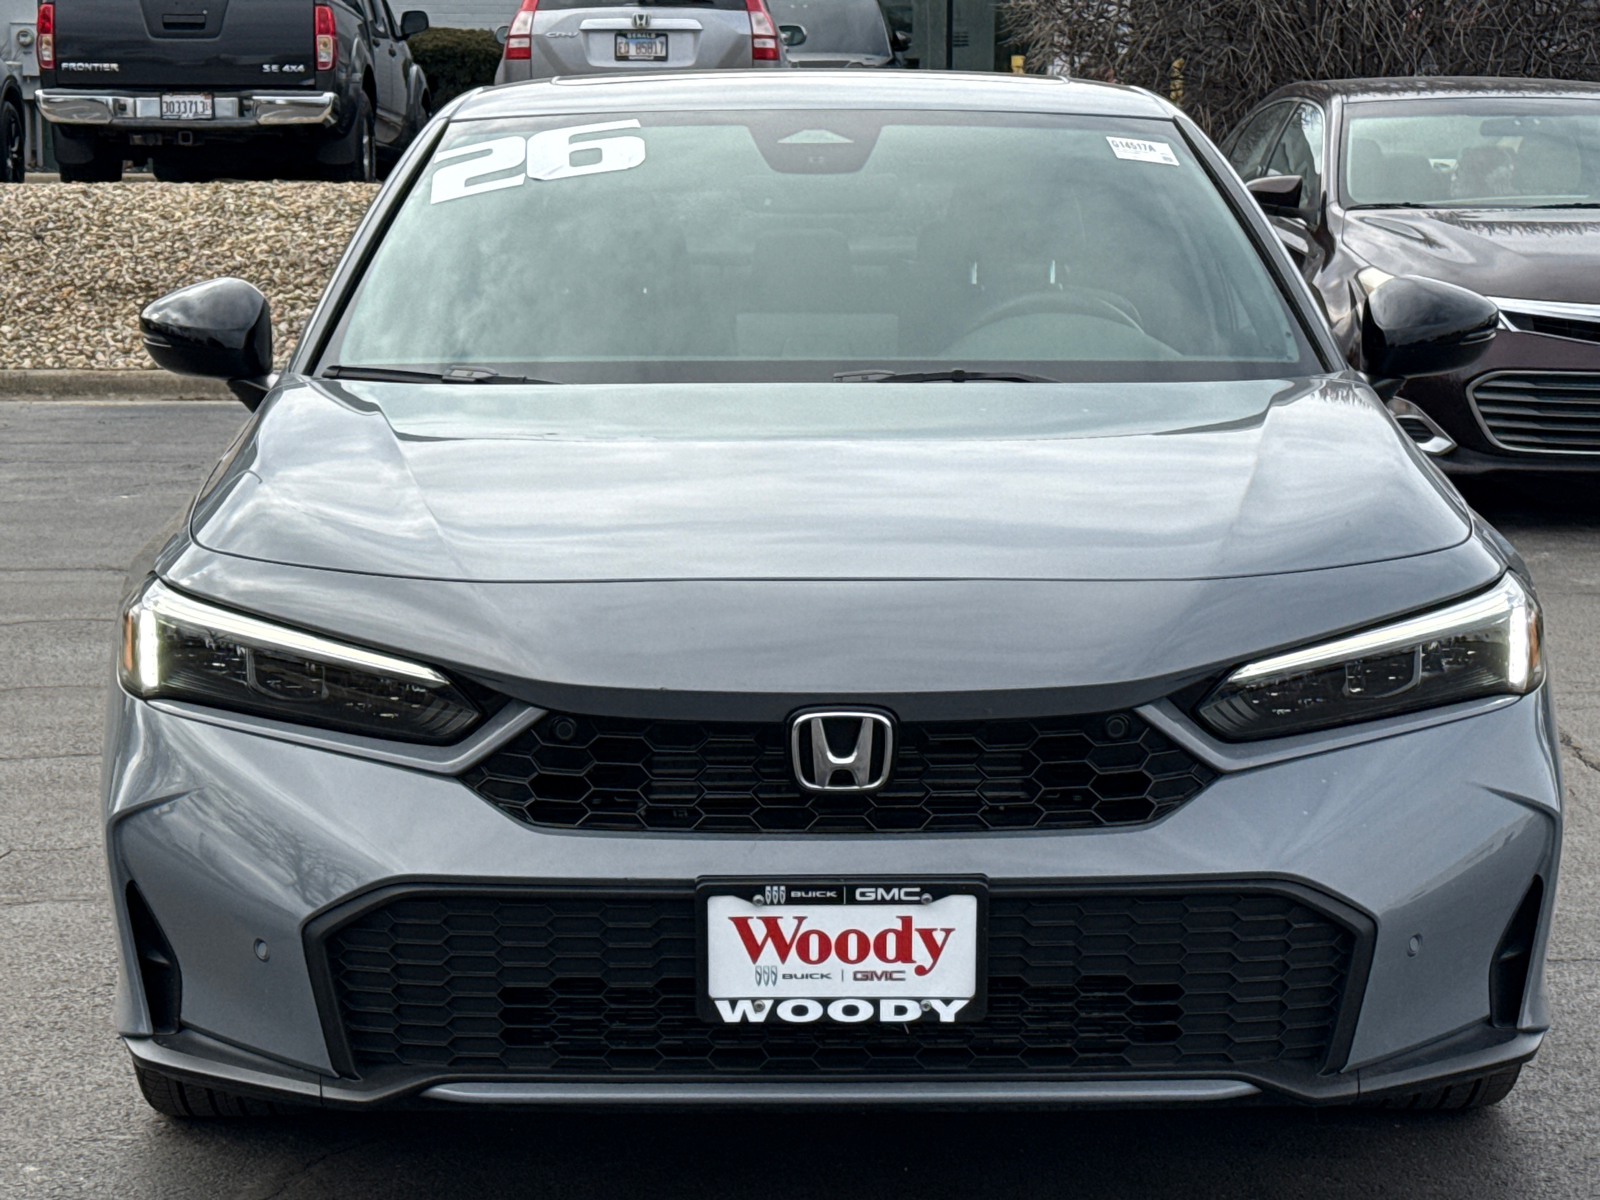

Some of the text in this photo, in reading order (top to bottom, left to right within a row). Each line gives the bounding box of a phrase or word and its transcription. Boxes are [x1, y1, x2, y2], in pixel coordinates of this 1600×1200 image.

[61, 62, 119, 72] FRONTIER
[262, 64, 280, 72] SE
[162, 100, 206, 114] 3033713
[430, 118, 646, 205] 26
[790, 887, 921, 901] BUICK GMC
[727, 915, 956, 976] Woody
[781, 970, 906, 982] BUICK GMC
[714, 999, 971, 1023] WOODY
